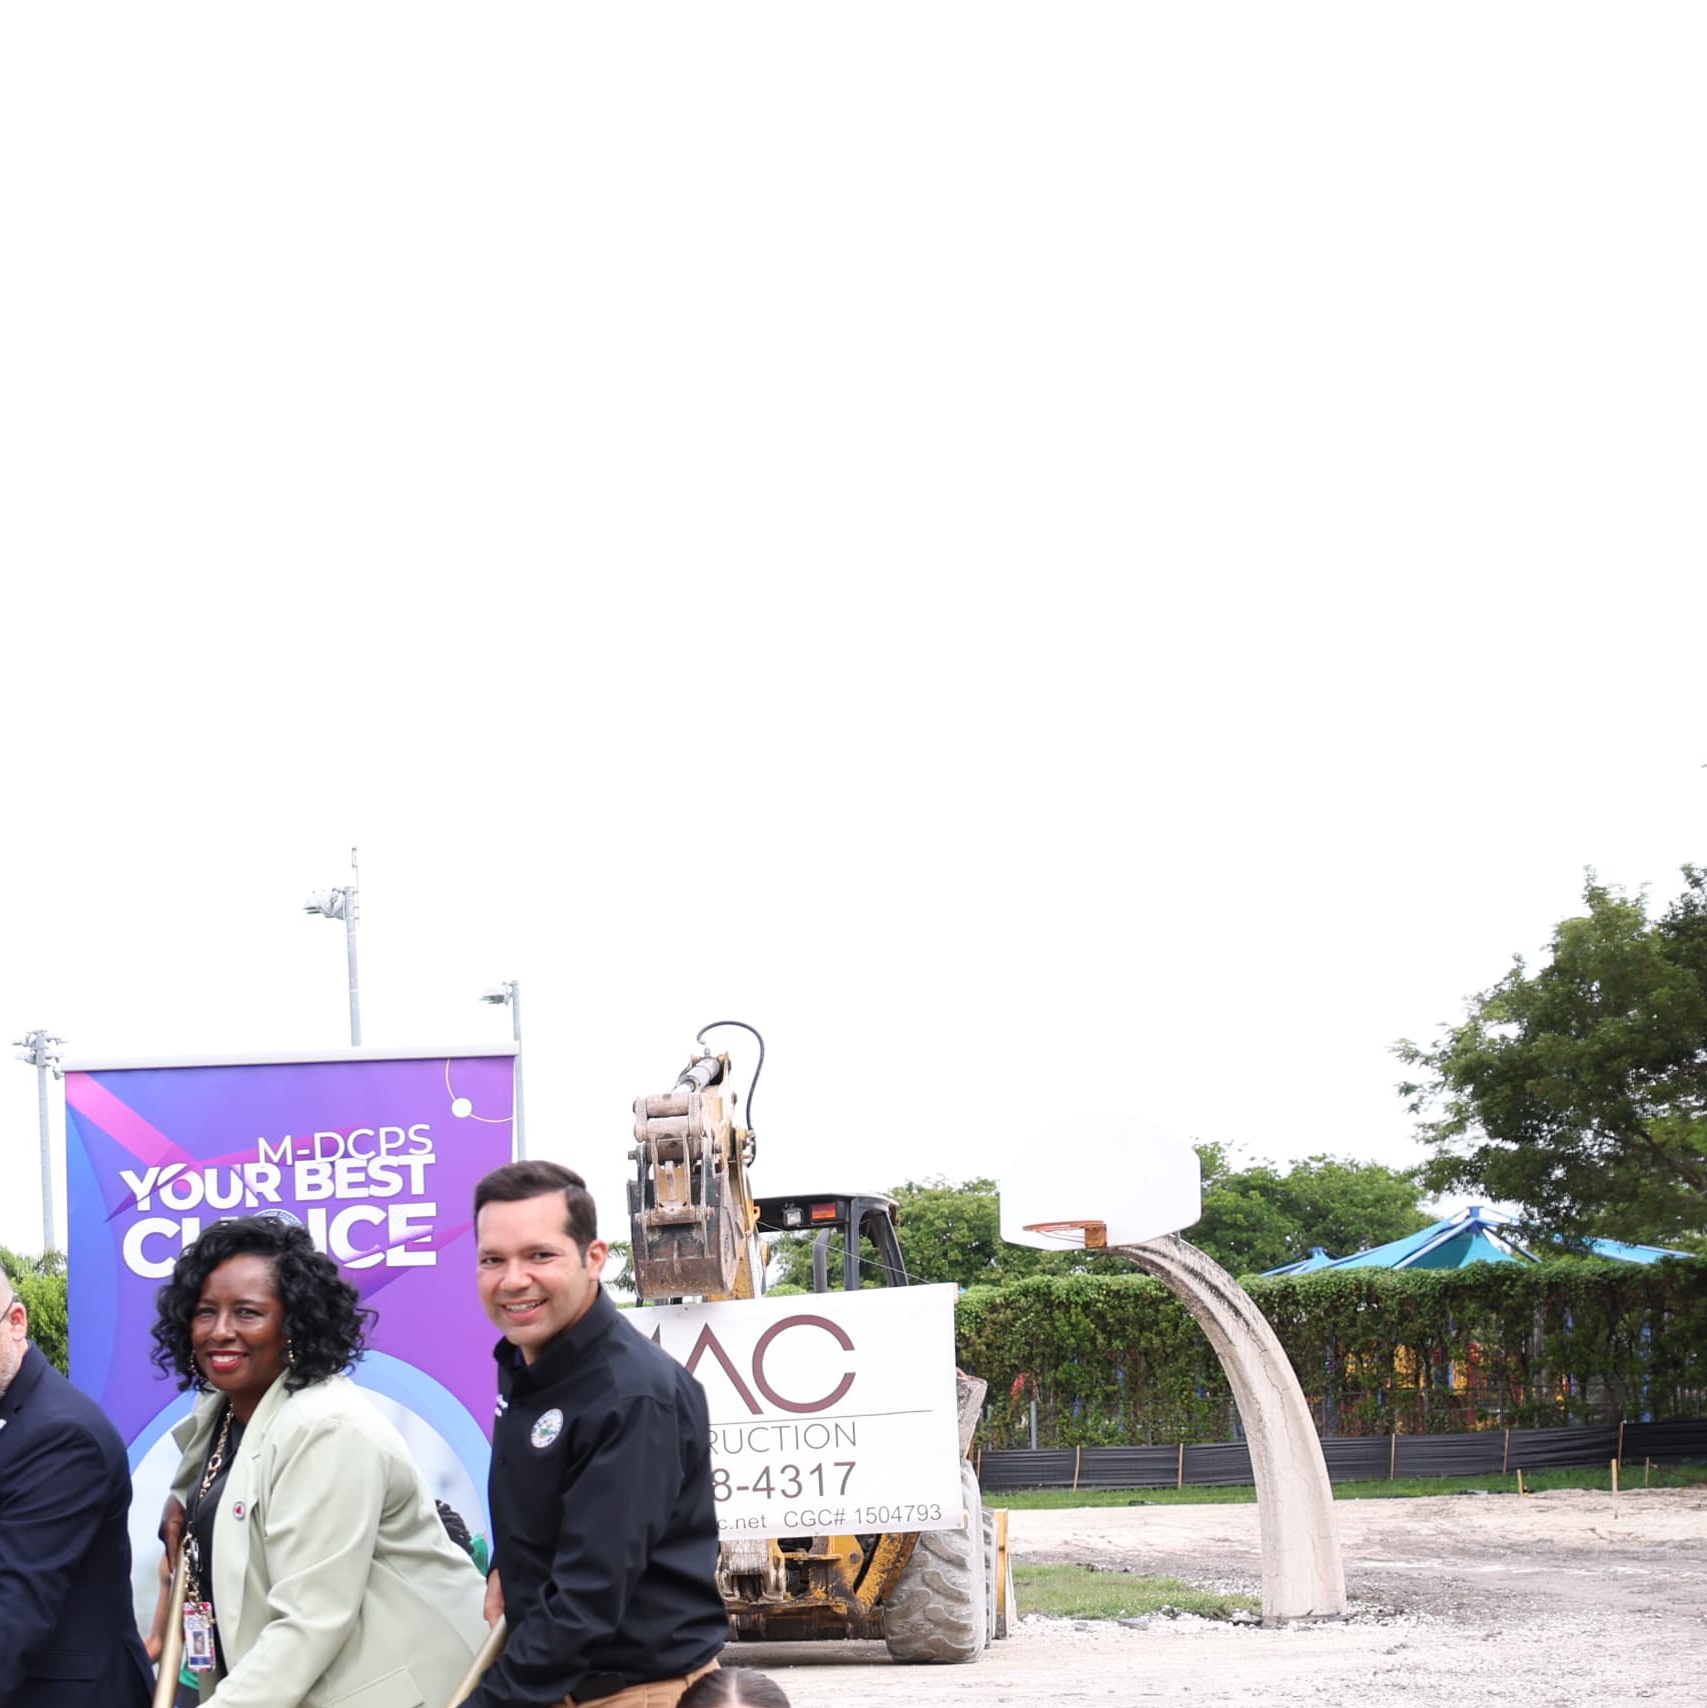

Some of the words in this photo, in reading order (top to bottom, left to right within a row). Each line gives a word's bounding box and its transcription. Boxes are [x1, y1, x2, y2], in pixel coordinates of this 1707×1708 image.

[258, 1124, 434, 1168] M-DCPS
[119, 1163, 282, 1211] YOUR
[293, 1153, 436, 1201] BEST
[122, 1202, 437, 1279] CICE
[651, 1314, 857, 1416] AC
[709, 1421, 857, 1456] RUCTION
[784, 1509, 846, 1528] CGC#
[855, 1503, 942, 1524] 1504793
